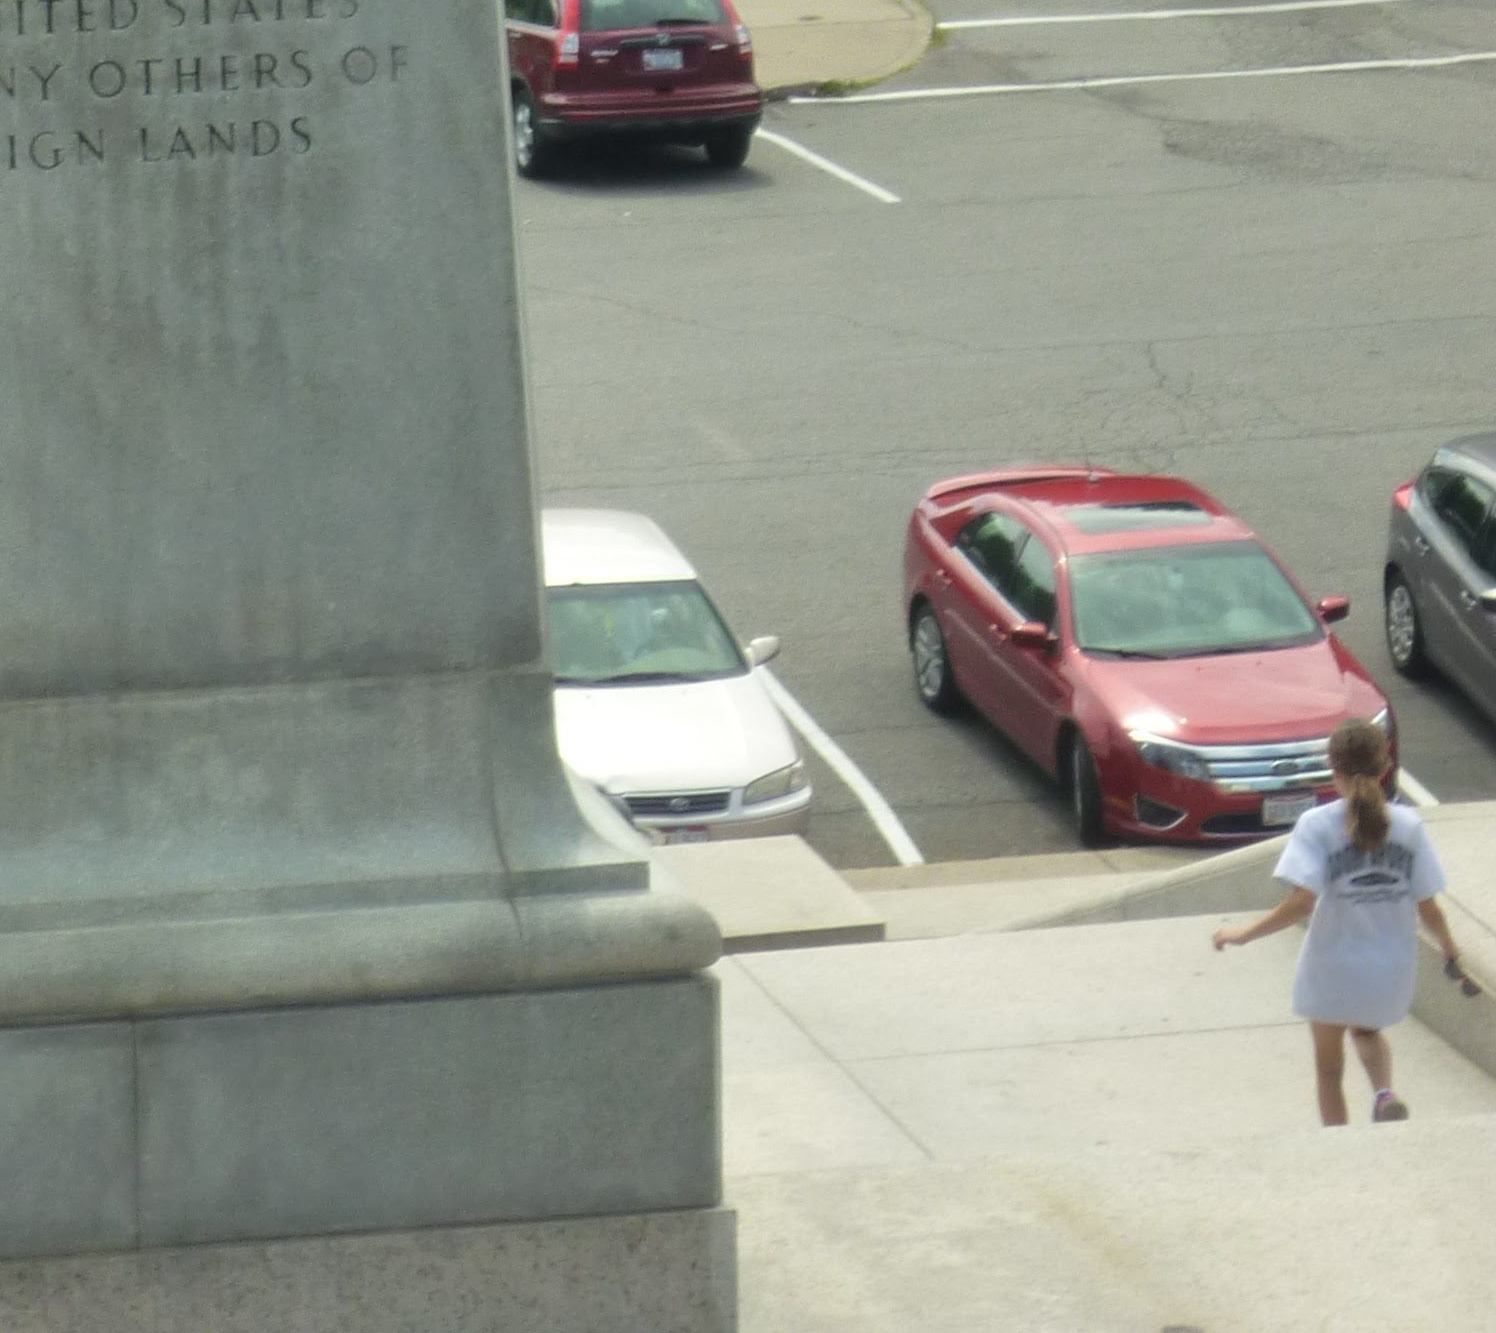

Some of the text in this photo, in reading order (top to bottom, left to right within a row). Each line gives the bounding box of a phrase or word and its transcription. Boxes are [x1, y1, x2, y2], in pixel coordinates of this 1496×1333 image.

[89, 49, 312, 98] OTHERS
[341, 44, 410, 85] OF
[140, 117, 312, 163] LANDS
